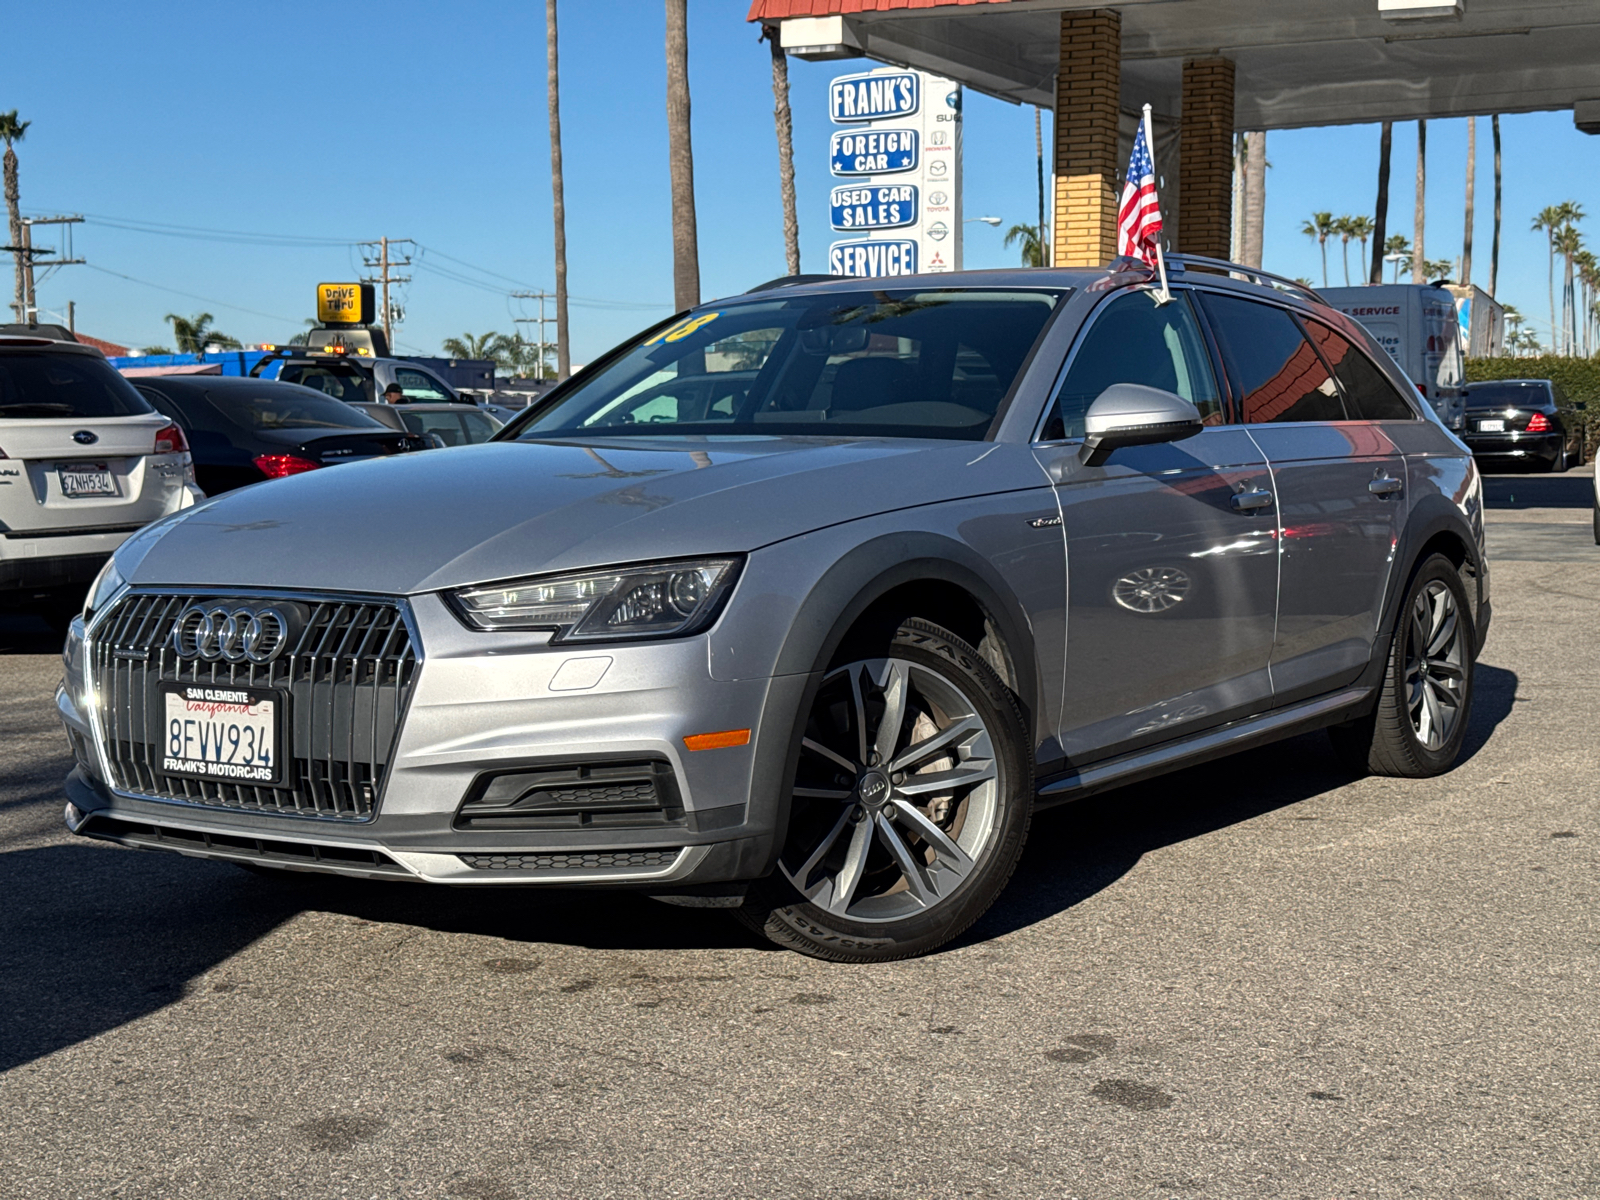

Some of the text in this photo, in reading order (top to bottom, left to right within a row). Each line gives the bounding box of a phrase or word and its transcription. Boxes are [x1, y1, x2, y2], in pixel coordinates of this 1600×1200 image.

[832, 78, 912, 117] FRANK'S
[832, 132, 911, 157] FOREIGN
[854, 154, 889, 171] CAR
[832, 186, 911, 208] USED CAR
[842, 204, 901, 227] SALES
[831, 244, 911, 278] SERVICE
[1352, 306, 1400, 316] SERVICE
[643, 312, 720, 347] 18
[62, 473, 109, 491] 6ZNH534
[186, 687, 249, 703] SAN CLEMENTE
[186, 701, 258, 719] California
[169, 718, 271, 767] 8FVV934
[163, 757, 273, 781] FRANK'S MOTORCARS
